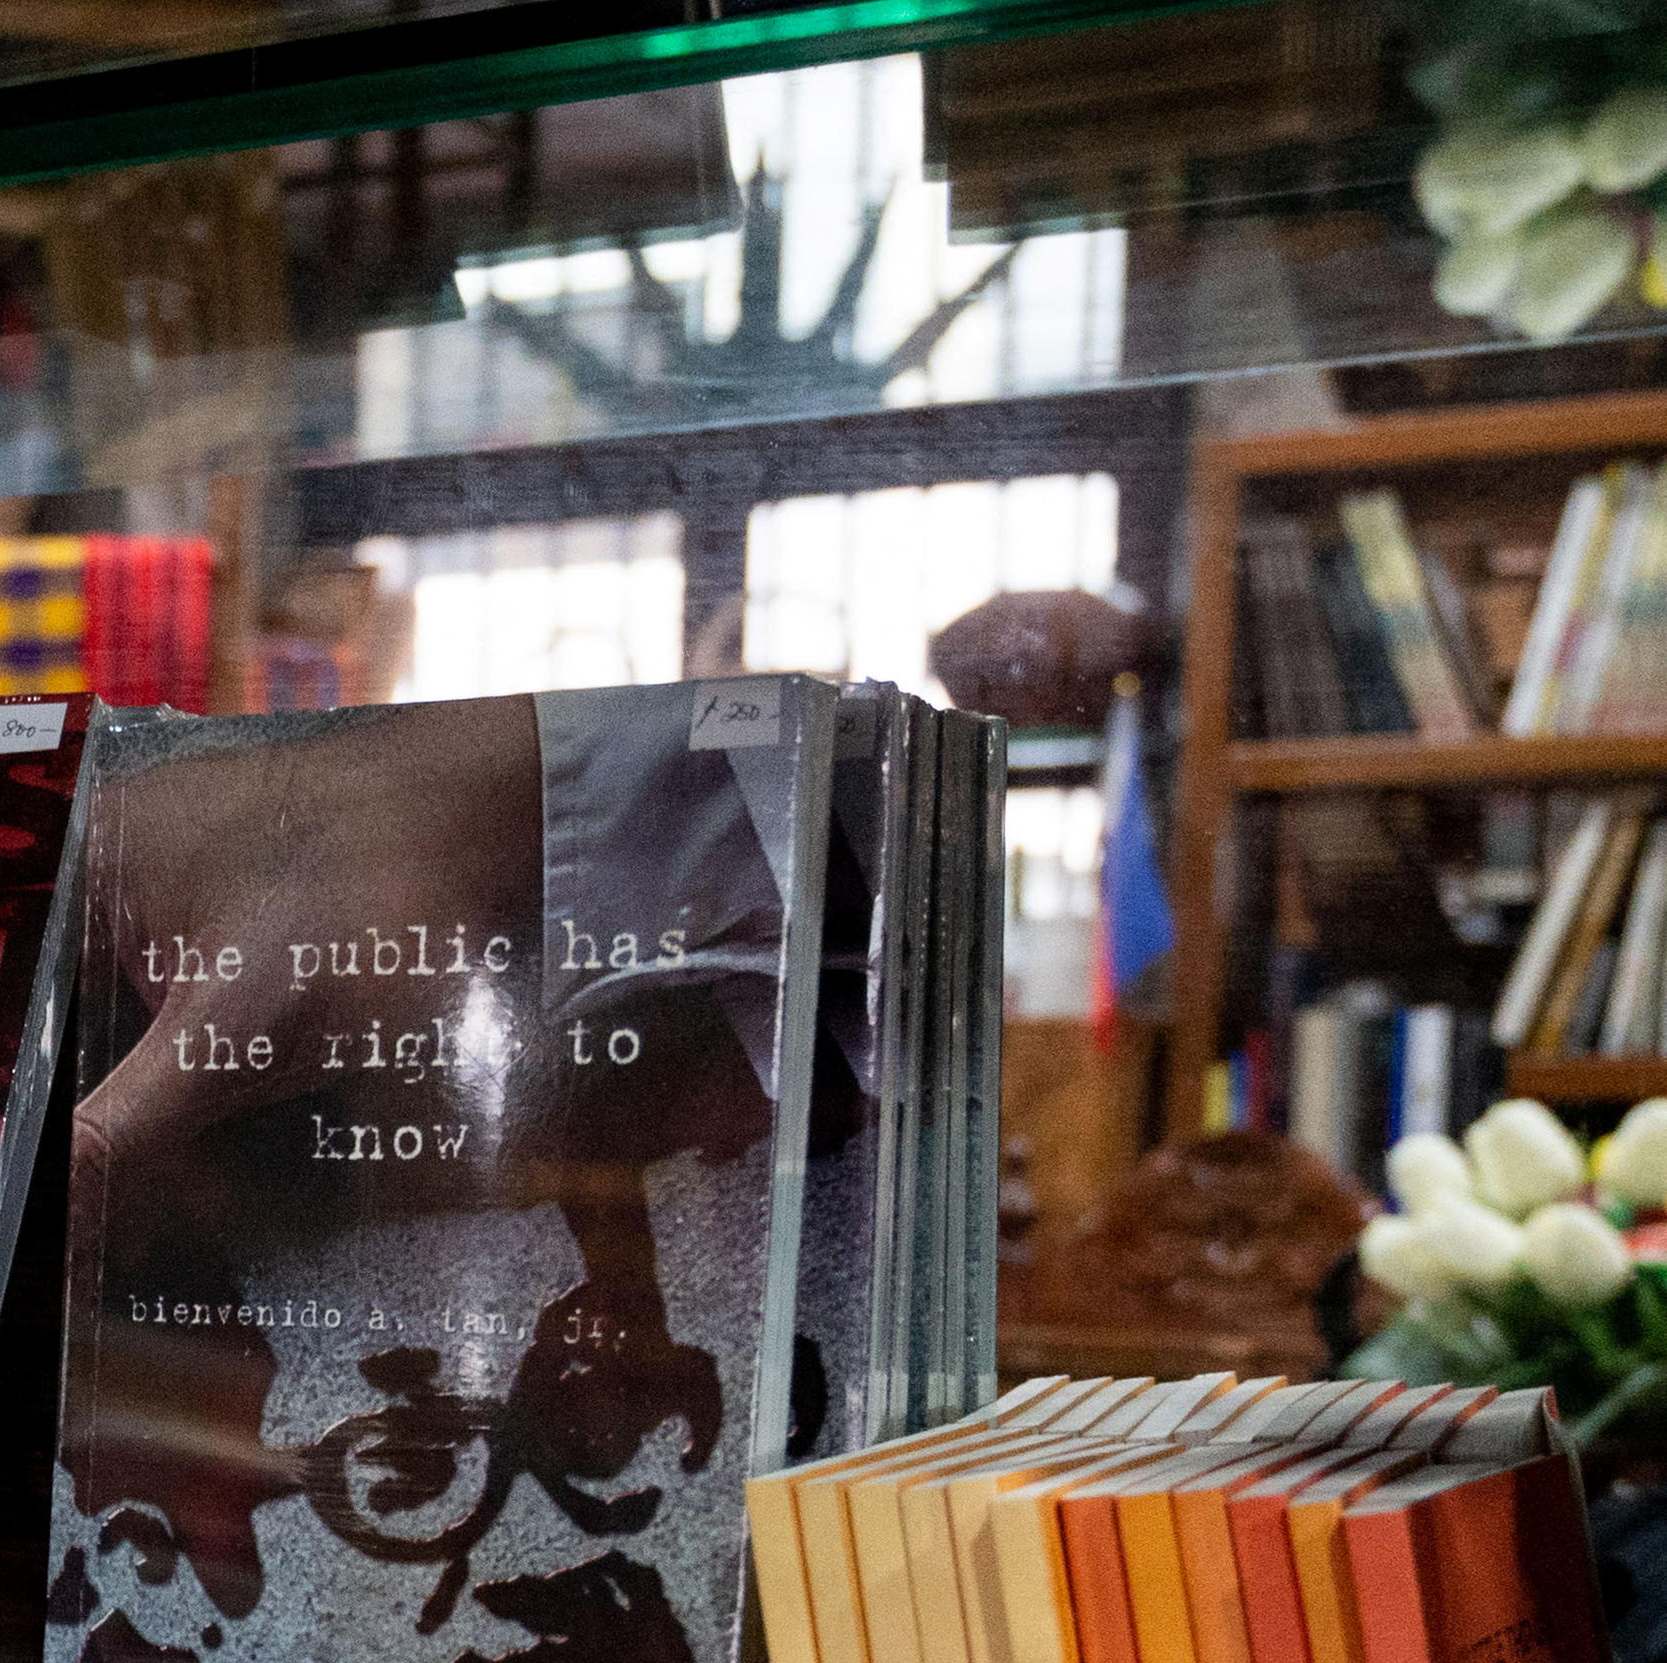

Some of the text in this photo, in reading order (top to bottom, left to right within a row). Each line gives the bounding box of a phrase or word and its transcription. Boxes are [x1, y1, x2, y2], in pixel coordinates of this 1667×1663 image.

[140, 920, 687, 992] the public has
[172, 1025, 274, 1072] the
[567, 1019, 640, 1065] to
[312, 1115, 468, 1161] know
[129, 1295, 342, 1328] bienvenido
